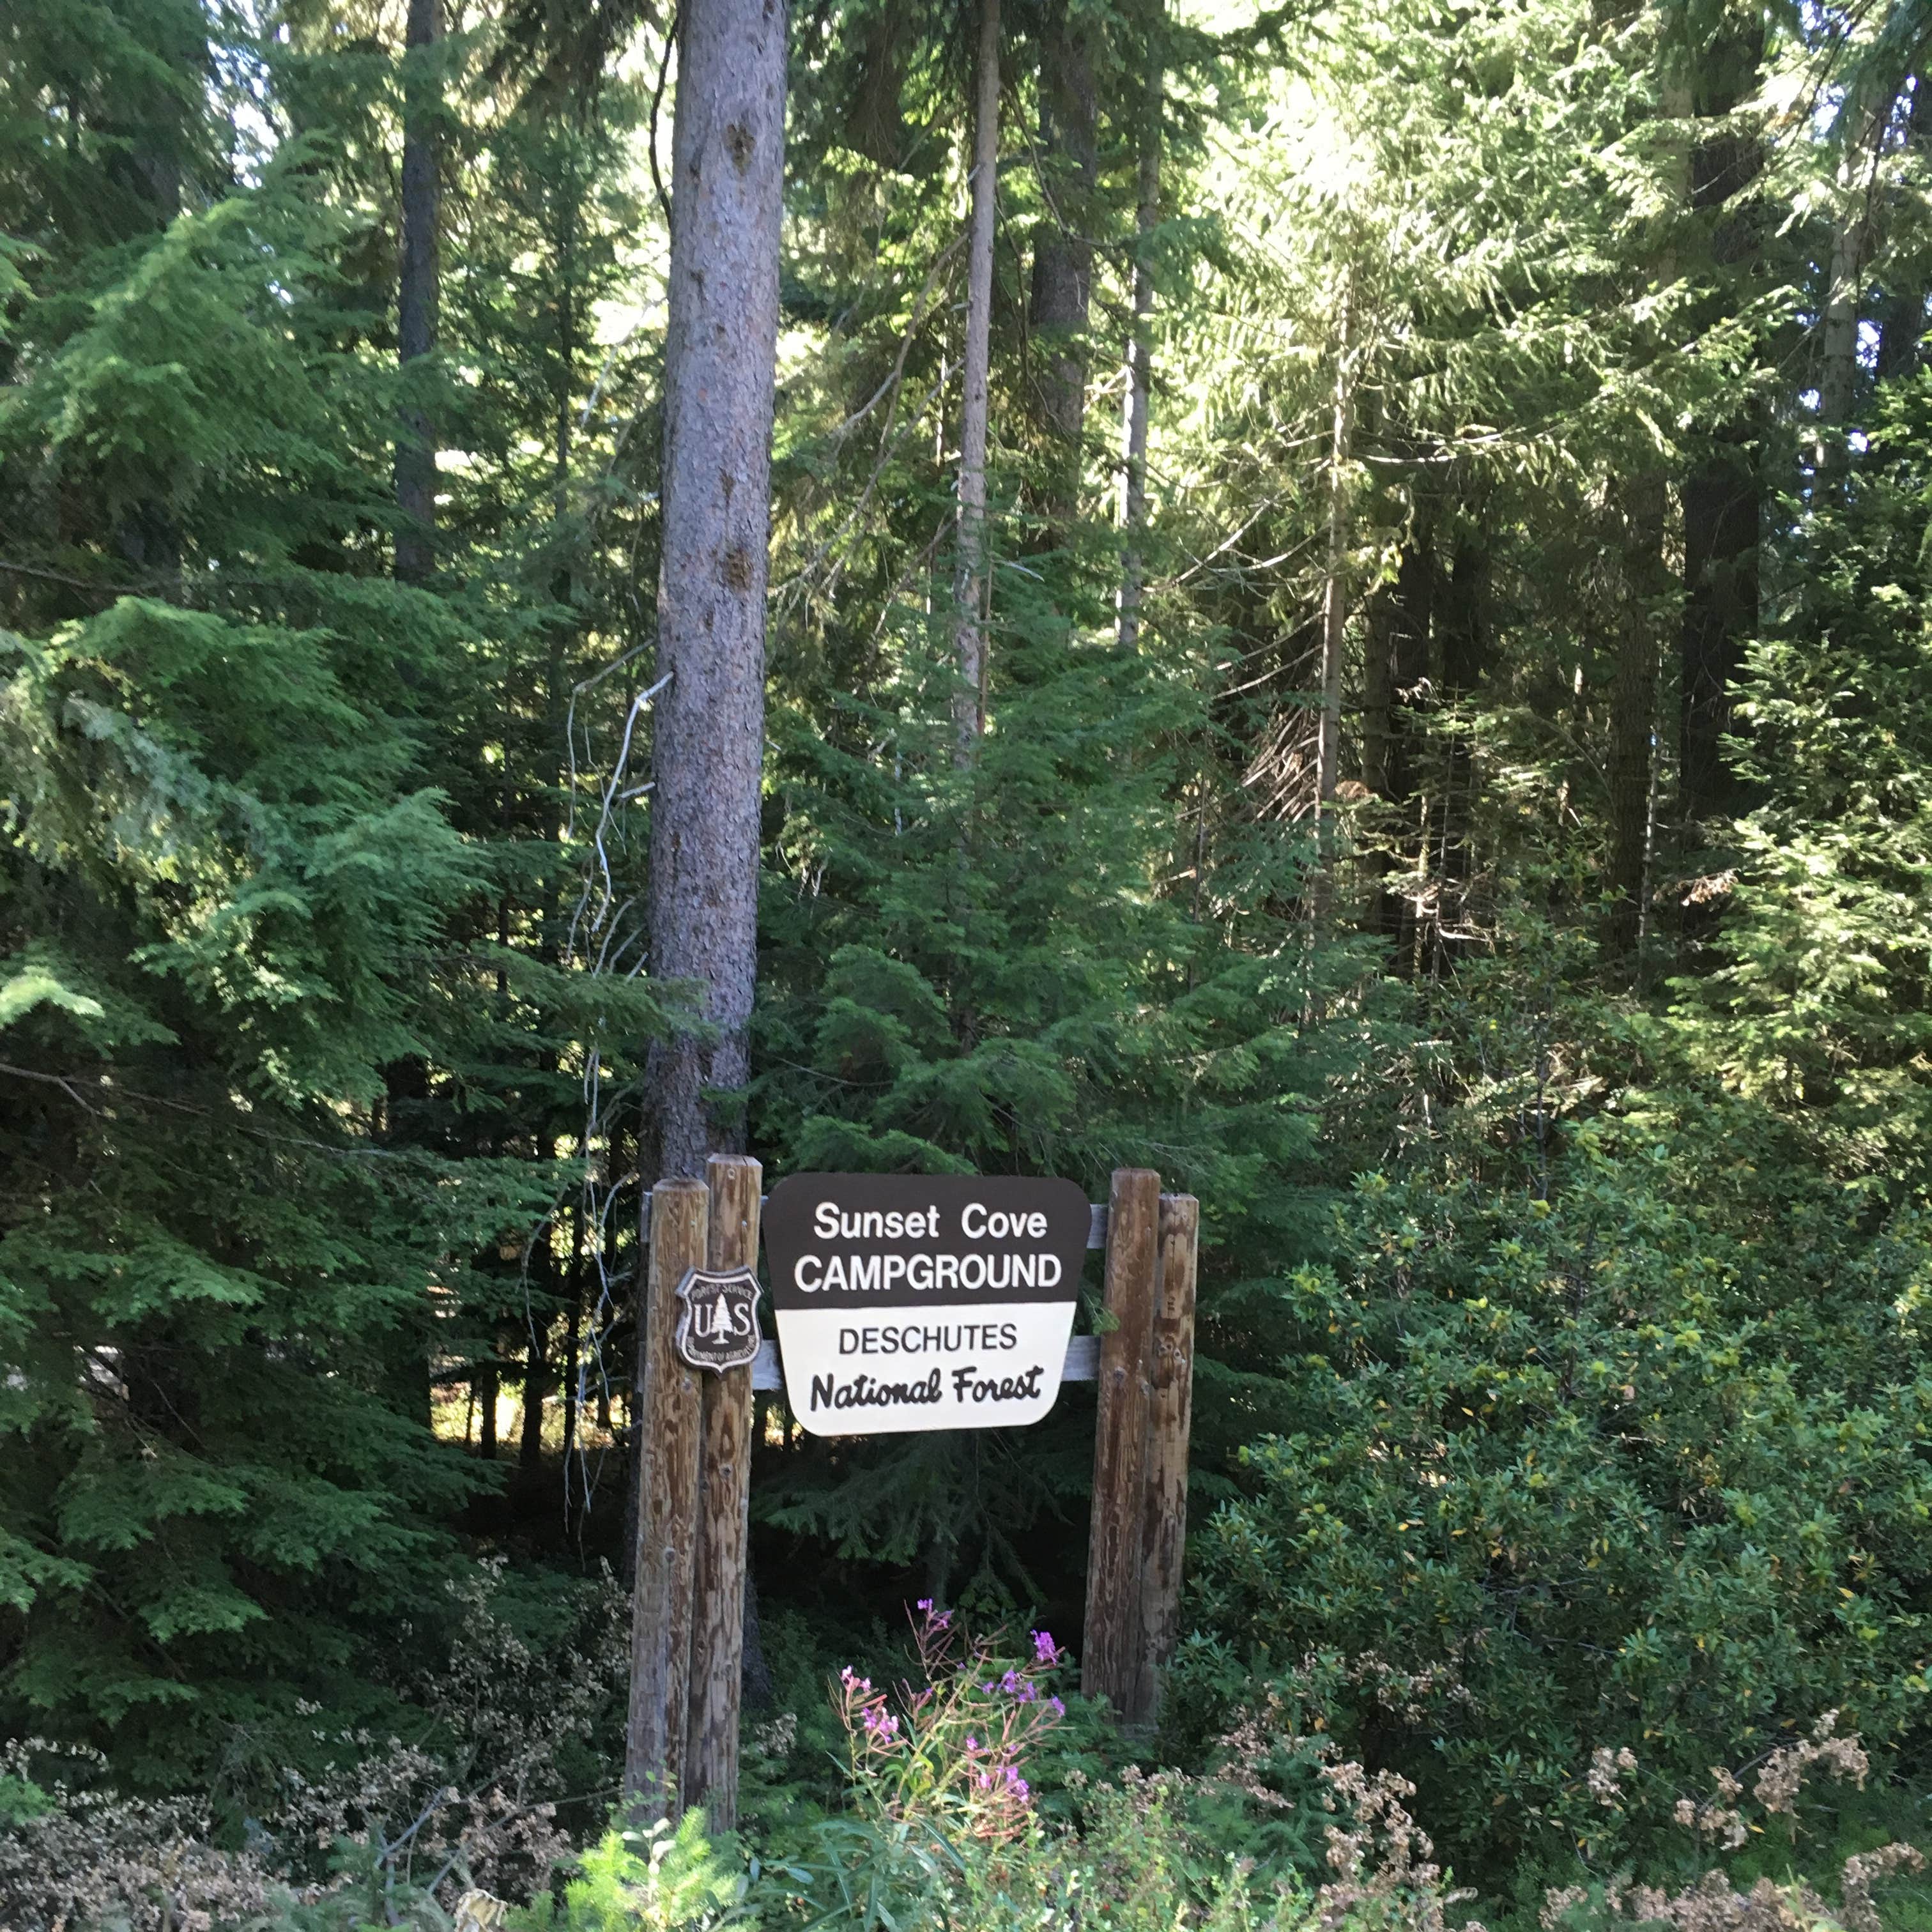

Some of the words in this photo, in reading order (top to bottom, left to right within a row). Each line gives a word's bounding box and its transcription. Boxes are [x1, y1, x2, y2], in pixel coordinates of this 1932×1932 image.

[814, 1202, 940, 1239] Sunset
[962, 1202, 1048, 1239] Cove
[794, 1254, 1062, 1292] CAMPGROUND
[839, 1324, 1017, 1354] DESCHUTES
[810, 1368, 942, 1411] National
[952, 1365, 1045, 1403] Forest
